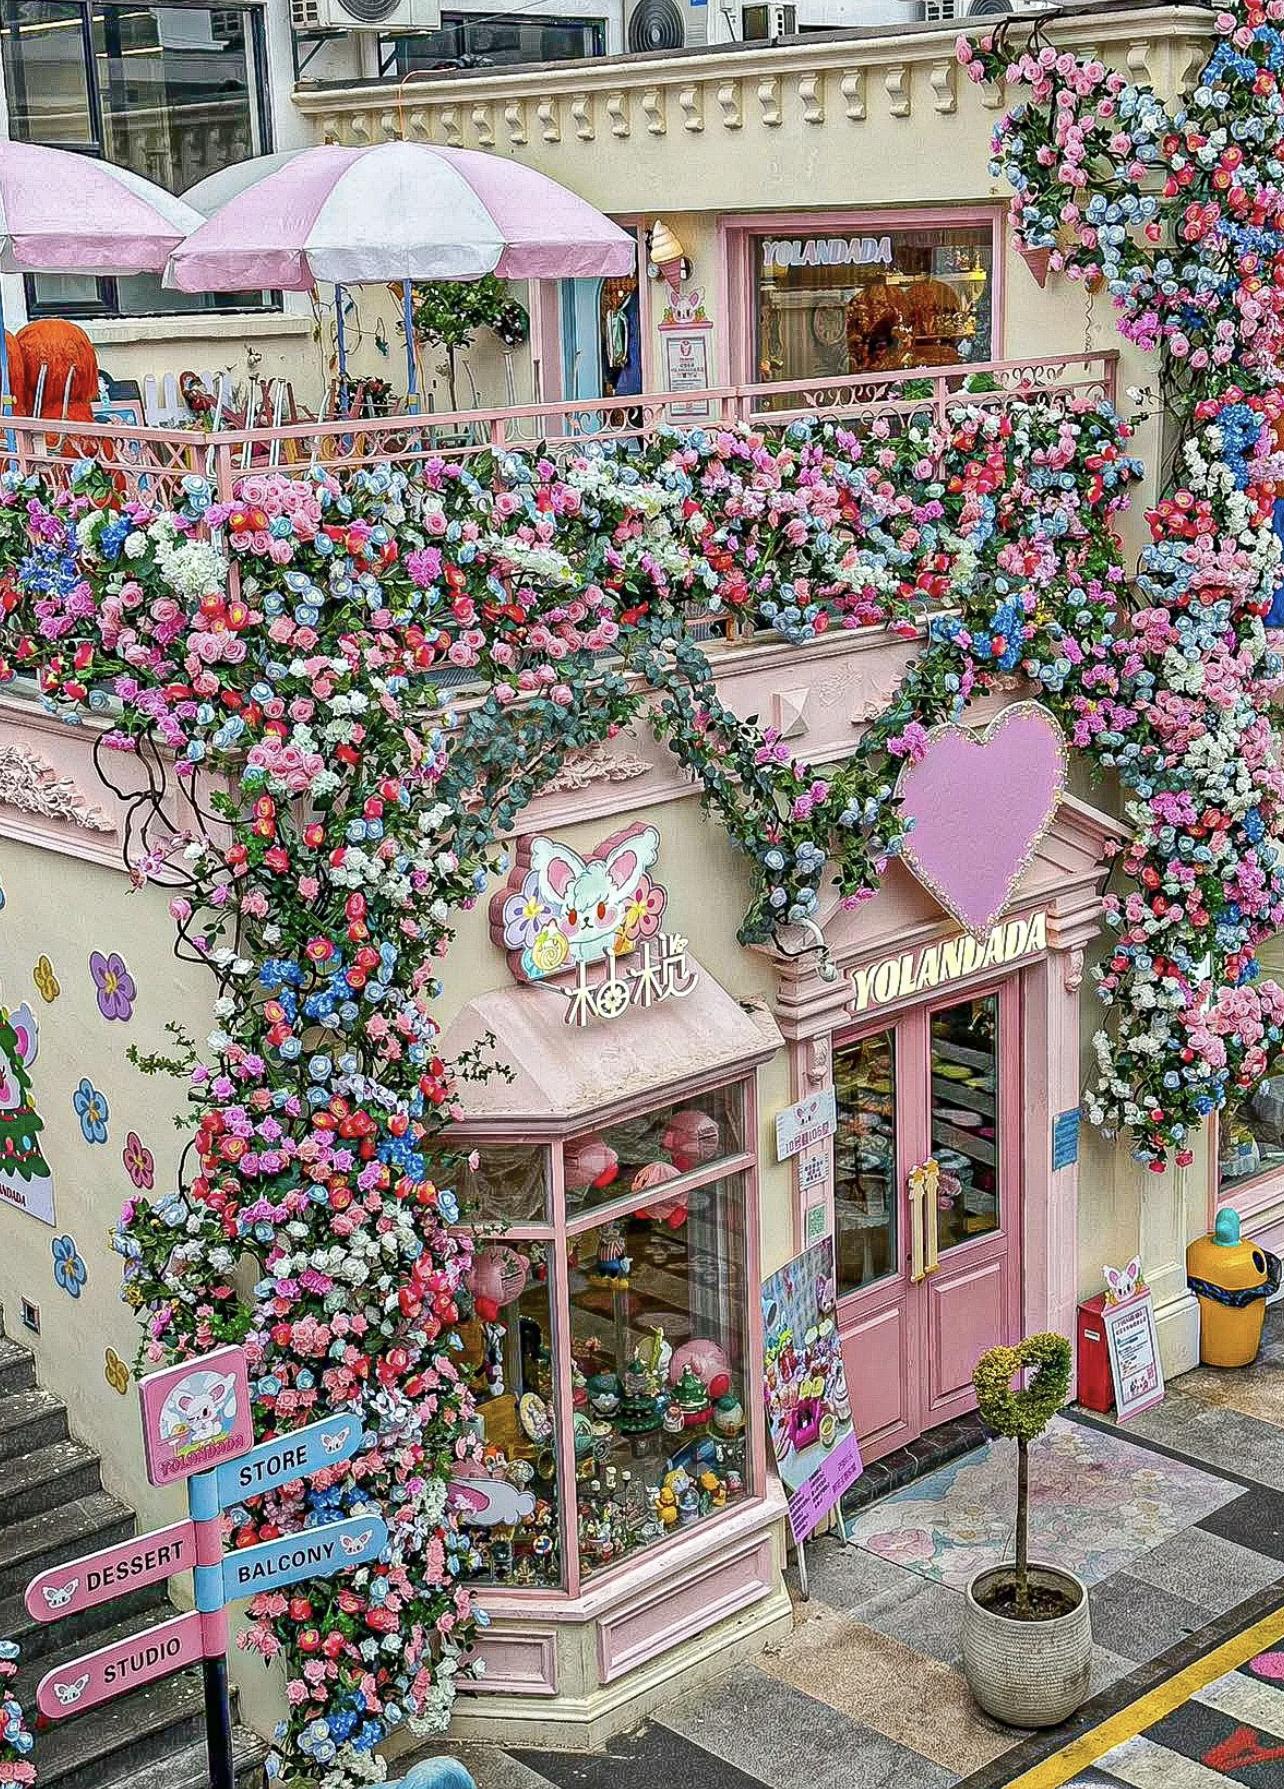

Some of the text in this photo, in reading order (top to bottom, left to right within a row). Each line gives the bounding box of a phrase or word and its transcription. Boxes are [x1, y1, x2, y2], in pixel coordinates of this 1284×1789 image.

[762, 236, 893, 267] YOLANDADA
[562, 932, 699, 1027] 柚榄
[851, 910, 1048, 1012] YOLANDADA
[239, 1445, 308, 1487] STORE
[87, 1541, 184, 1592] DESSERT
[238, 1542, 335, 1583] BALCONY
[104, 1638, 181, 1684] STUDIO
